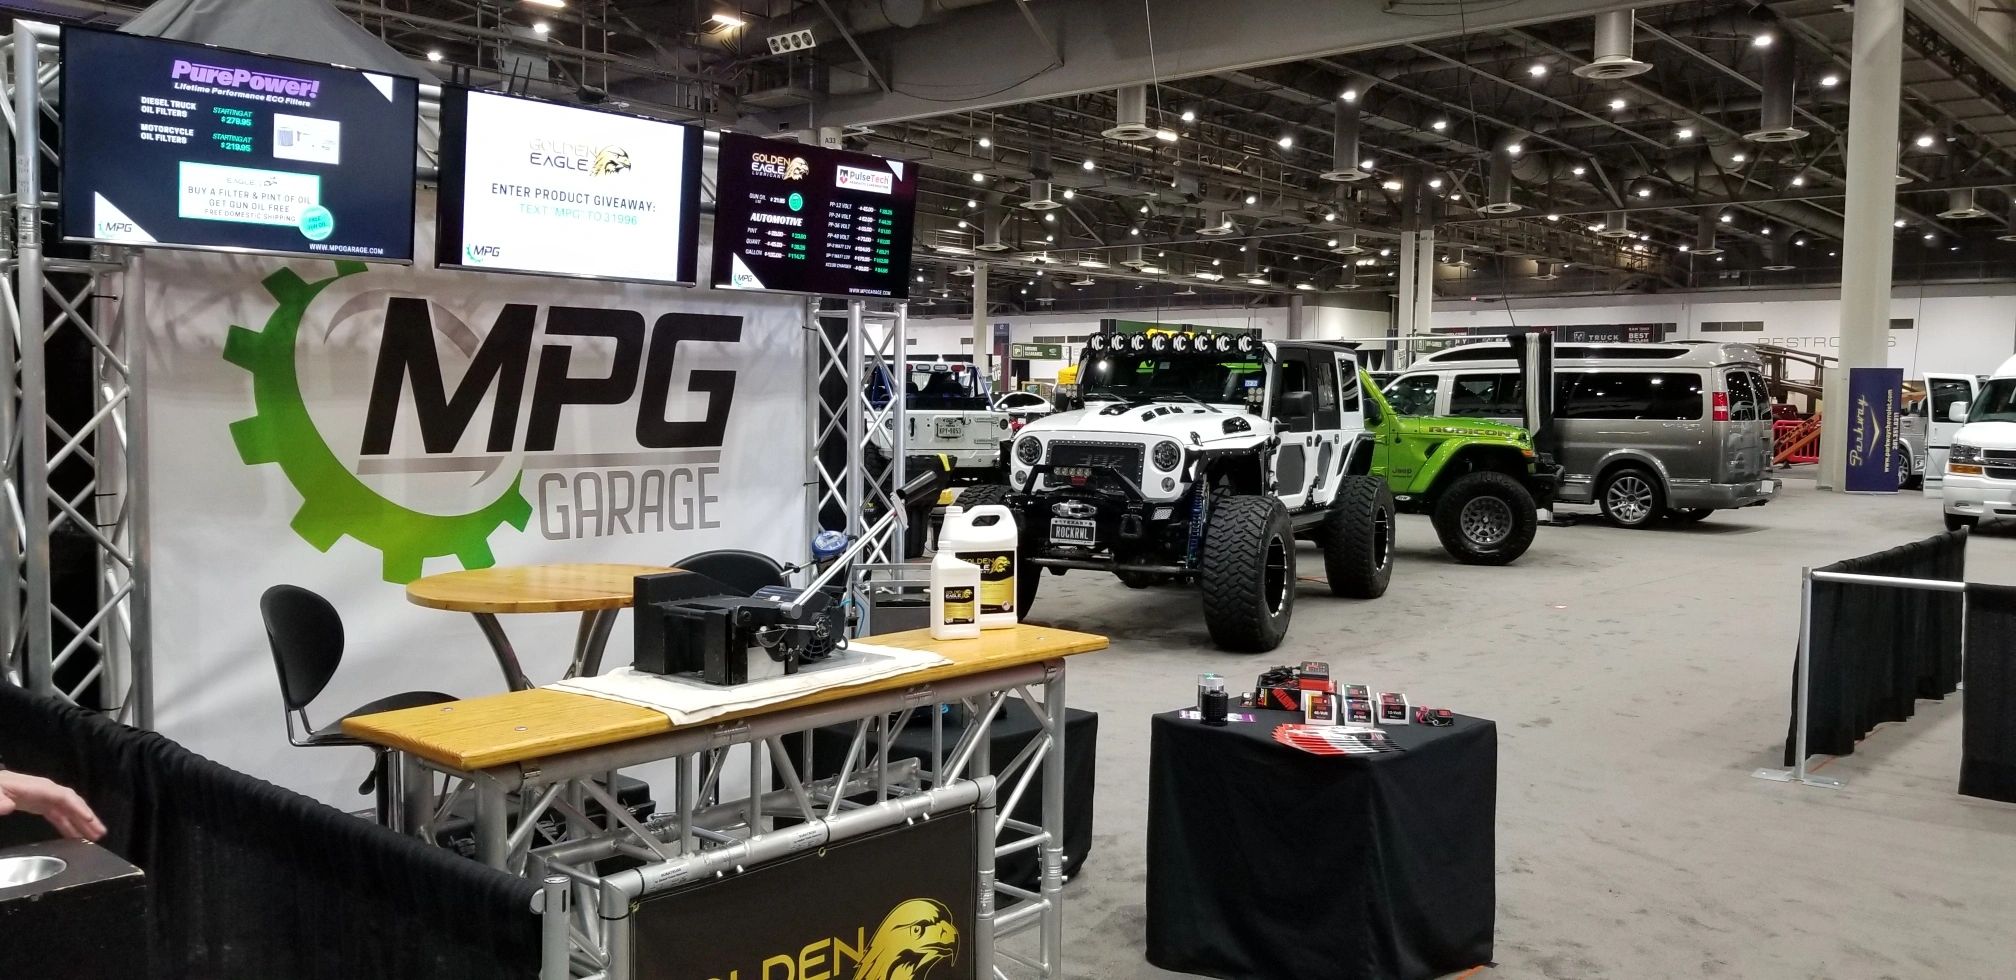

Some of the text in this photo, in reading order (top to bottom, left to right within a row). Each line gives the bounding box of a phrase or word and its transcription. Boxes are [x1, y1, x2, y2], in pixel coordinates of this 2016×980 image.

[171, 59, 320, 99] PurePower!
[174, 82, 311, 107] Lifetime Performance ECO Filters
[141, 96, 197, 110] DIESEL TRUCK
[141, 105, 188, 118] OIL FILTERS
[140, 123, 194, 137] MOTORCYCLE
[140, 132, 188, 144] OIL FILTERS
[530, 152, 589, 172] EAGLE
[752, 152, 791, 166] GOLDEN
[751, 161, 785, 175] EAGLE
[849, 171, 889, 185] PulseTech
[188, 186, 311, 204] BUY A FILTER & PINT OF OIL
[491, 183, 656, 212] ENTER PRODUCT GIVEAWAY:
[209, 199, 290, 212] GET GUN OIL FREE
[204, 208, 296, 222] FREE DOMESTIC SHIPPING
[519, 203, 547, 215] TEXT
[587, 210, 602, 222] TO
[604, 212, 638, 225] 31996
[750, 212, 804, 227] AUTOMOTIVE
[105, 221, 132, 232] MPG
[473, 245, 501, 257] MPG
[737, 274, 753, 282] MPG
[1091, 335, 1104, 350] KC
[1111, 335, 1124, 350] KC
[1131, 335, 1145, 350] KC
[1151, 335, 1166, 351] KC
[1173, 335, 1187, 351] KC
[1194, 335, 1208, 351] KC
[1216, 335, 1230, 352] KC
[1237, 335, 1253, 352] KC
[358, 296, 744, 456] MPG
[1428, 426, 1511, 437] RUBICON
[1849, 394, 1869, 467] Parkway
[537, 465, 721, 541] GARAGE
